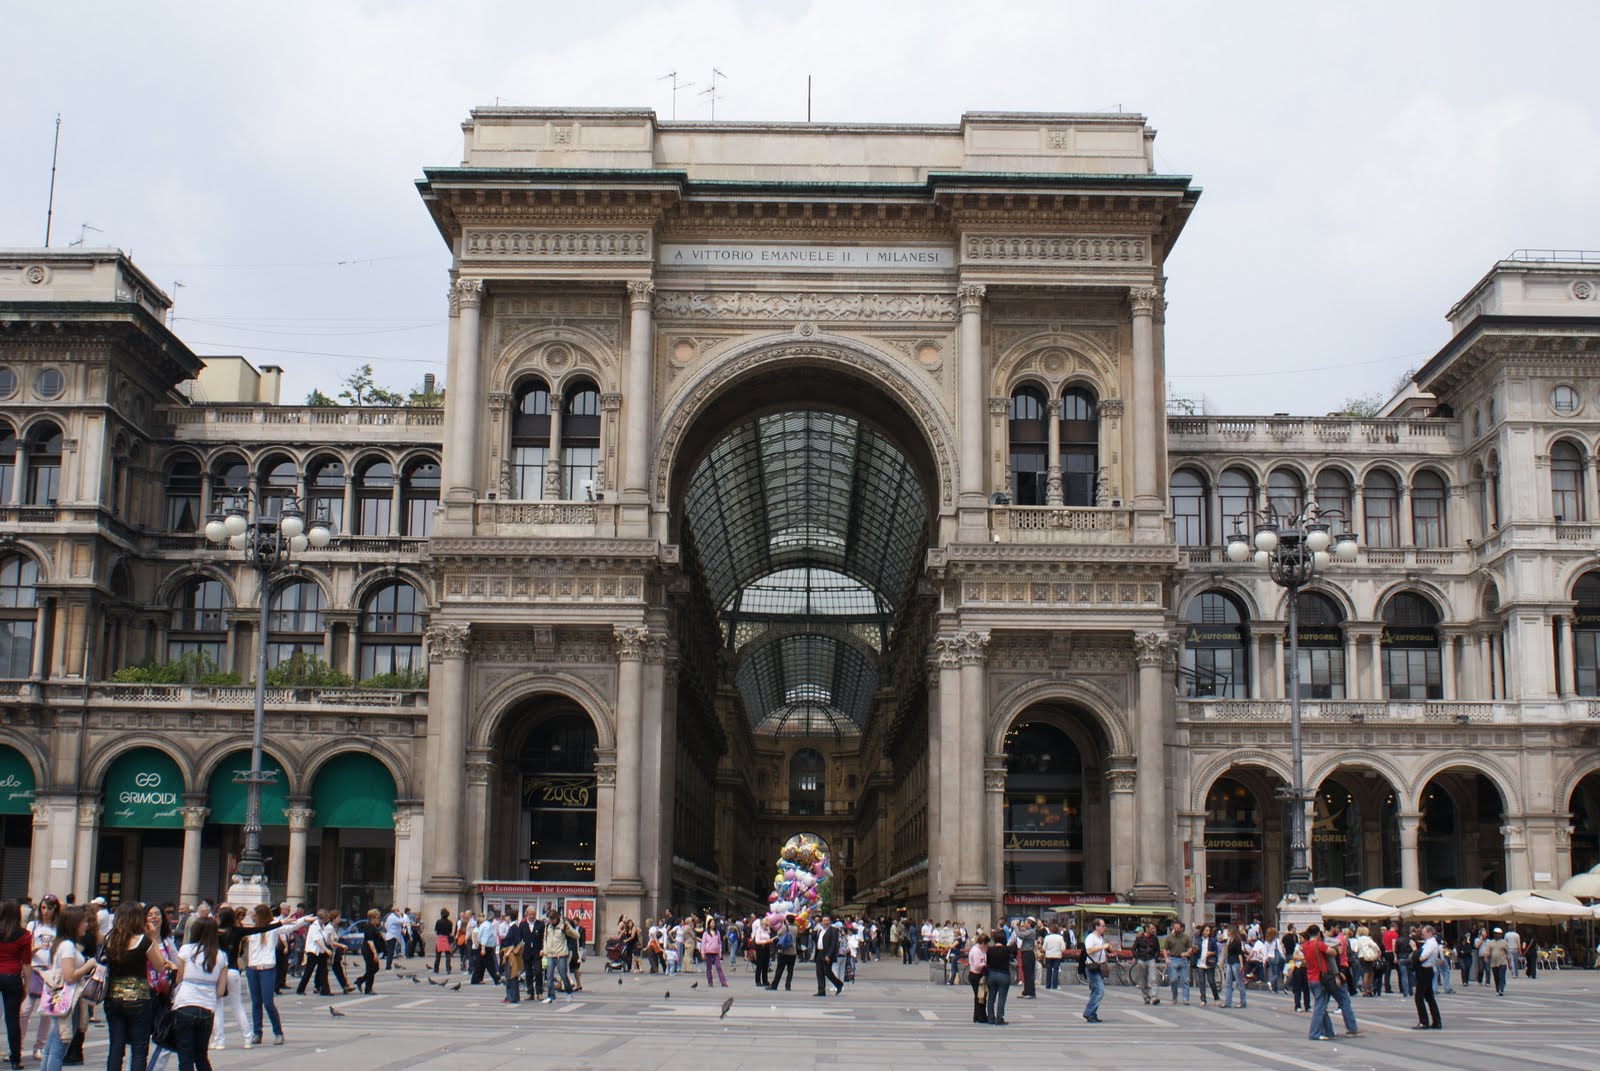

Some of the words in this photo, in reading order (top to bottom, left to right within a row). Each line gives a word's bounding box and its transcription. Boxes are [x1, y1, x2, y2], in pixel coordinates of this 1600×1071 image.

[675, 250, 683, 260] A
[692, 250, 754, 261] VITTORIO
[761, 250, 835, 261] EMANUELE
[877, 252, 939, 263] MILANESI
[1298, 633, 1338, 641] AUTOGRILL
[119, 791, 176, 805] GRIMOLDI
[542, 786, 589, 807] ZUCCO
[1312, 834, 1347, 842] OGRILL
[1023, 839, 1070, 847] AUTOGRILL
[1207, 840, 1255, 848] AUTOGRILL
[480, 884, 493, 892] The
[495, 884, 533, 893] Economist
[556, 886, 594, 894] Economist
[1020, 895, 1051, 903] Repubblica
[1076, 895, 1106, 903] Repubblica
